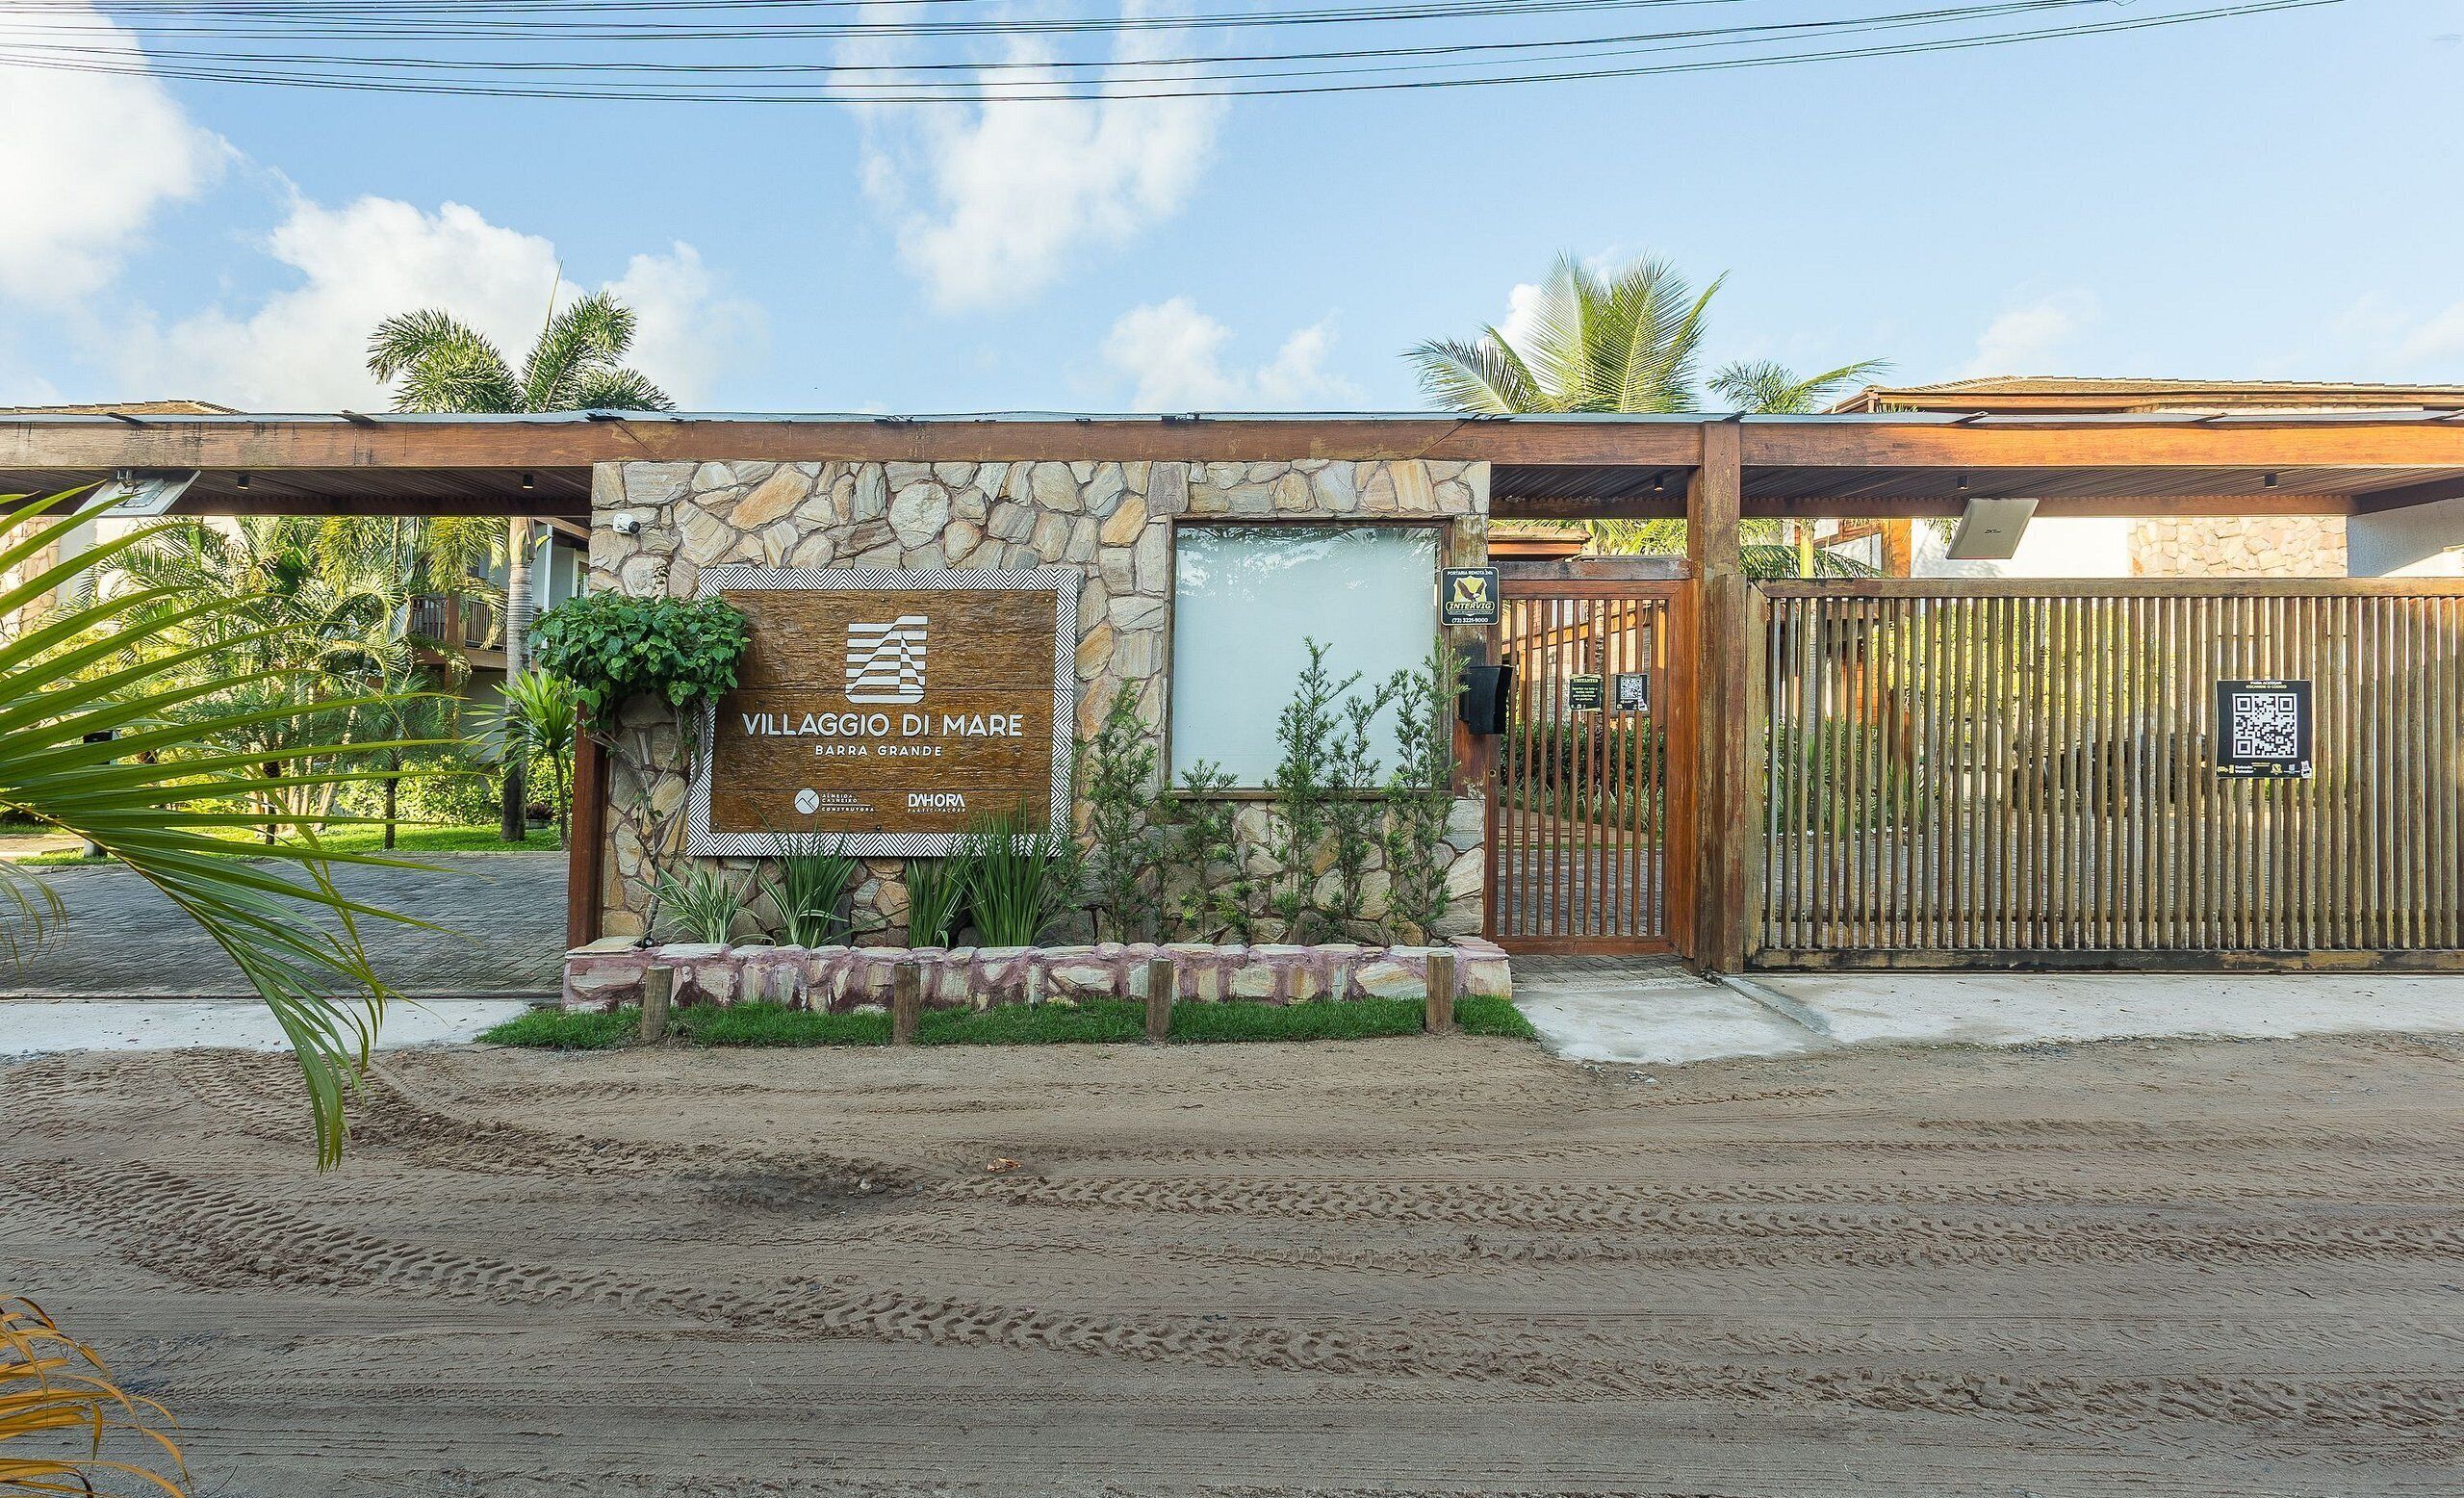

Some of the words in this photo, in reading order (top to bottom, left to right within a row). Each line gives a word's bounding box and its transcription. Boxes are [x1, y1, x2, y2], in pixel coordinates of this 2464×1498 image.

[742, 712, 890, 736] VILLAGGIO
[902, 712, 929, 736] DI
[942, 712, 1024, 736] MARE
[815, 744, 868, 756] BARRA
[877, 745, 942, 757] GRANDE
[908, 793, 965, 807] DAHORA
